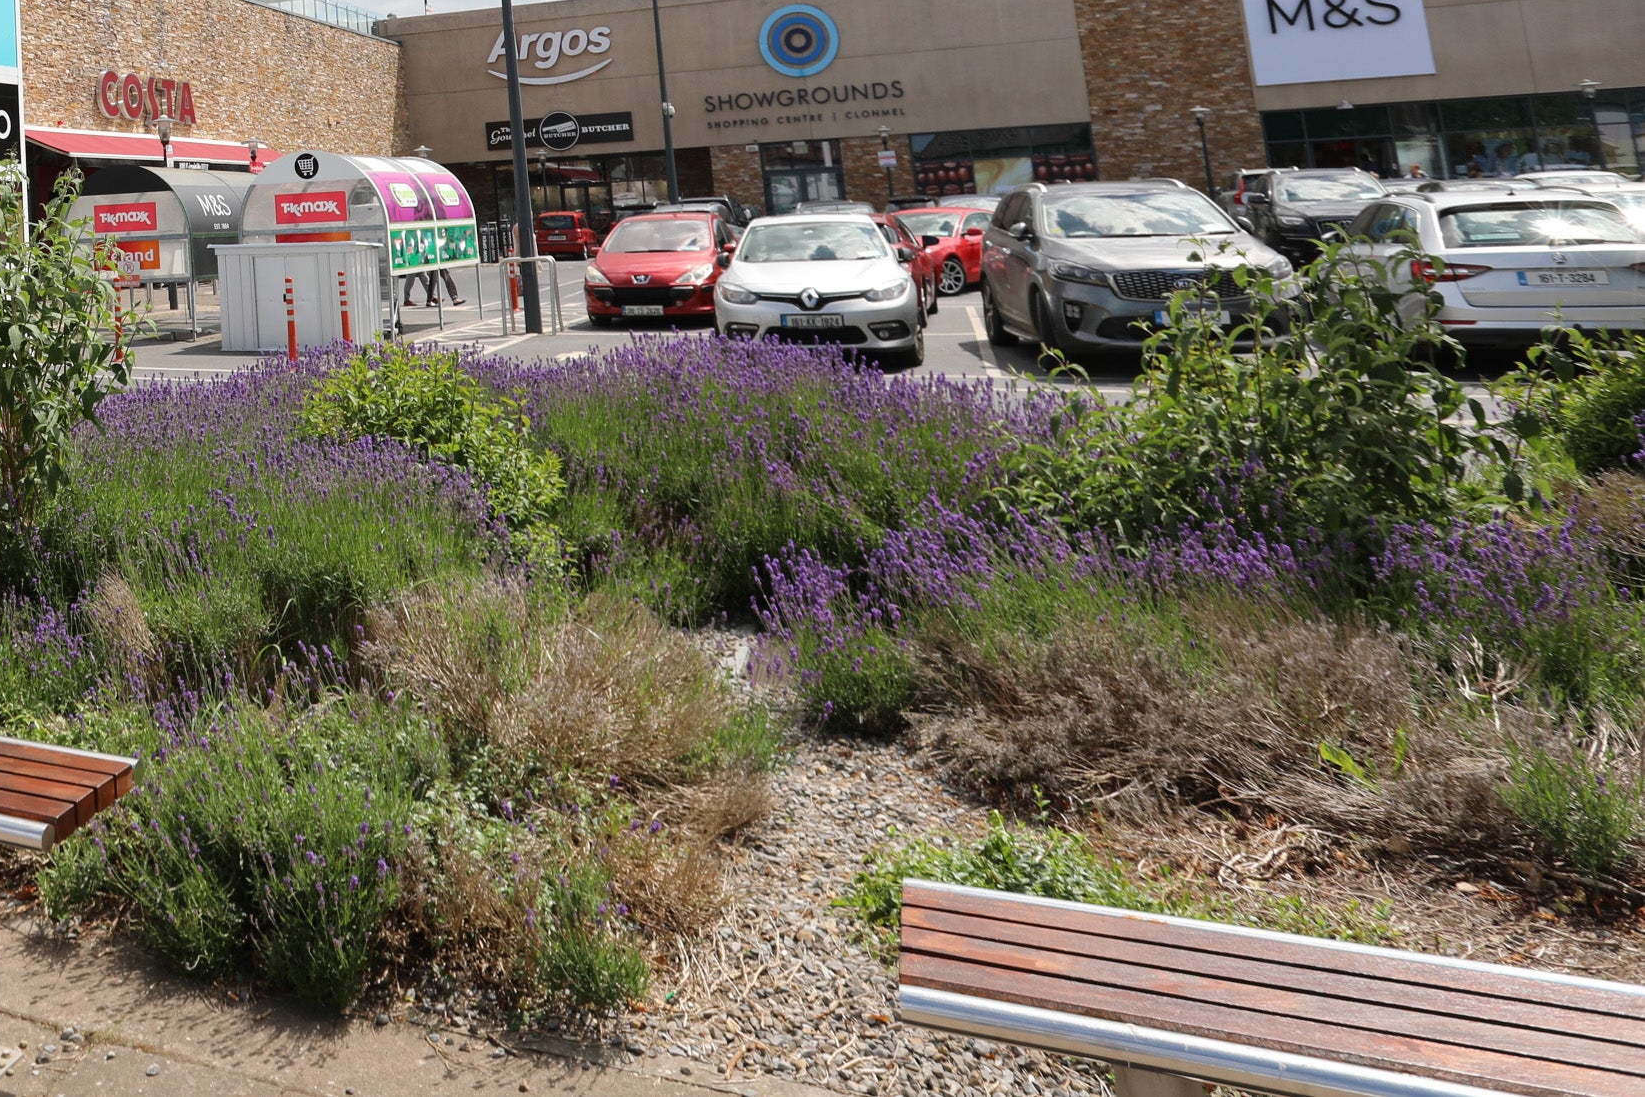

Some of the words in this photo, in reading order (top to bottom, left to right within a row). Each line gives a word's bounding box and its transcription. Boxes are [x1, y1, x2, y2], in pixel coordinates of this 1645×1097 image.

[486, 26, 612, 70] Argos
[96, 70, 197, 127] COSTA
[704, 80, 904, 113] SHOWGROUNDS
[581, 123, 630, 134] BUTCHER
[707, 116, 769, 129] SHOPPING
[776, 113, 823, 124] CENTRE
[844, 107, 906, 119] CLONMEL
[196, 193, 232, 217] M&S
[790, 316, 840, 328] 161-KK-1924
